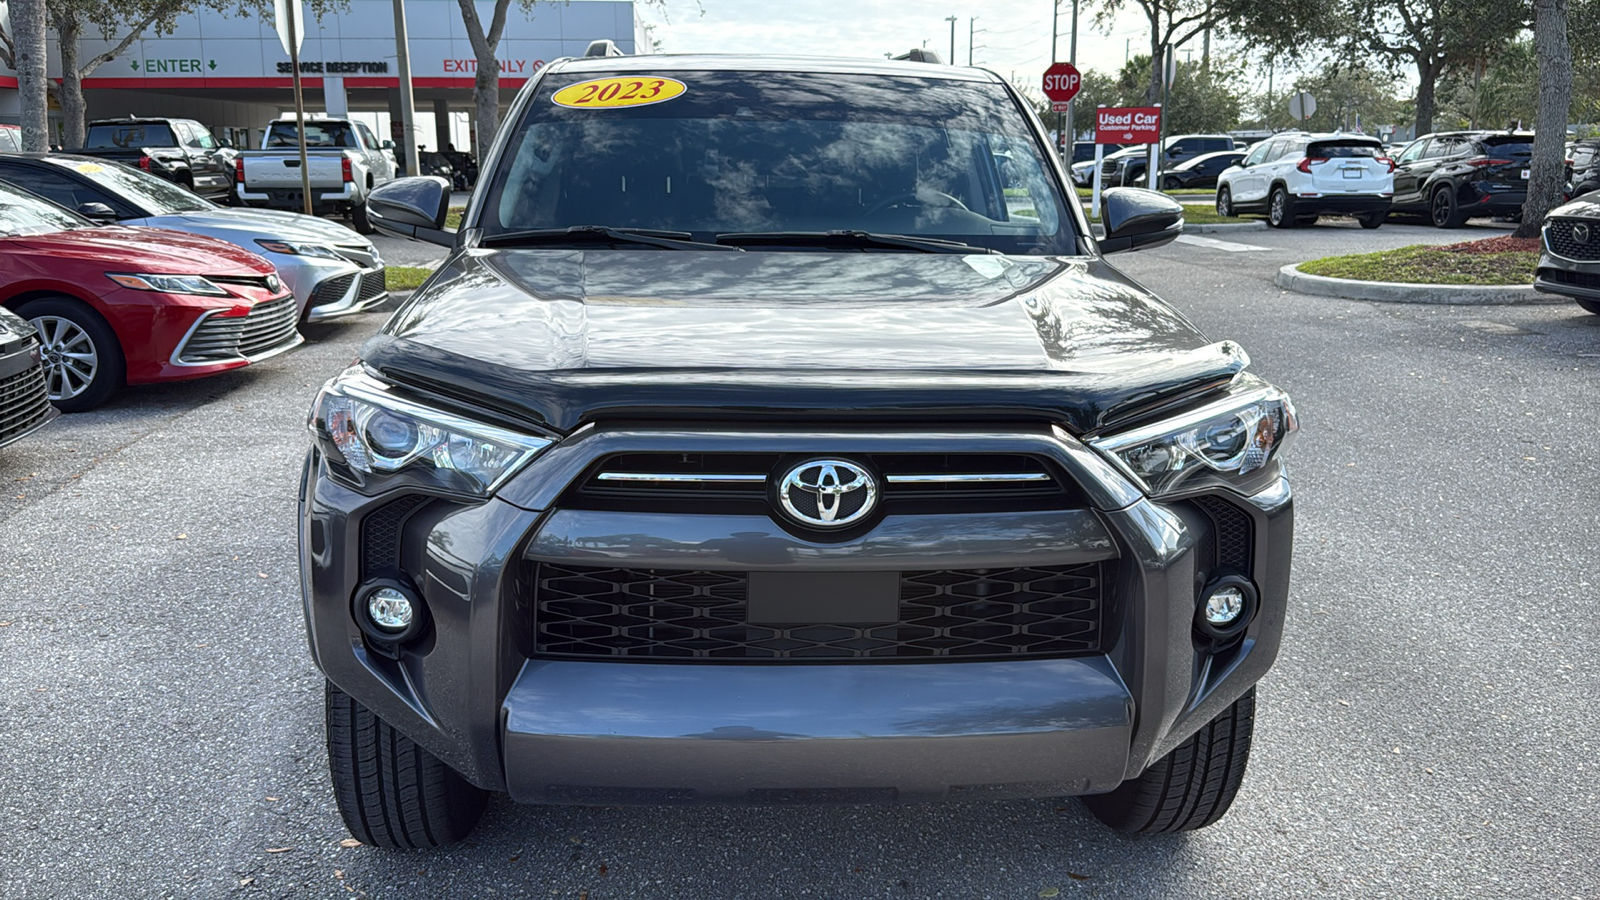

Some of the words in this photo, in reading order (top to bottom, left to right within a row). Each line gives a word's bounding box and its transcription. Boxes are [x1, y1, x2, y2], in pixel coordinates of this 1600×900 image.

[145, 59, 202, 73] ENTER
[276, 61, 324, 74] SEVICE
[325, 61, 388, 74] RECEPTION
[443, 59, 478, 72] EXIT
[1045, 75, 1078, 90] STOP
[573, 80, 665, 104] 2023
[1099, 113, 1132, 125] Used
[1134, 113, 1158, 125] Car
[1131, 124, 1156, 132] Parking
